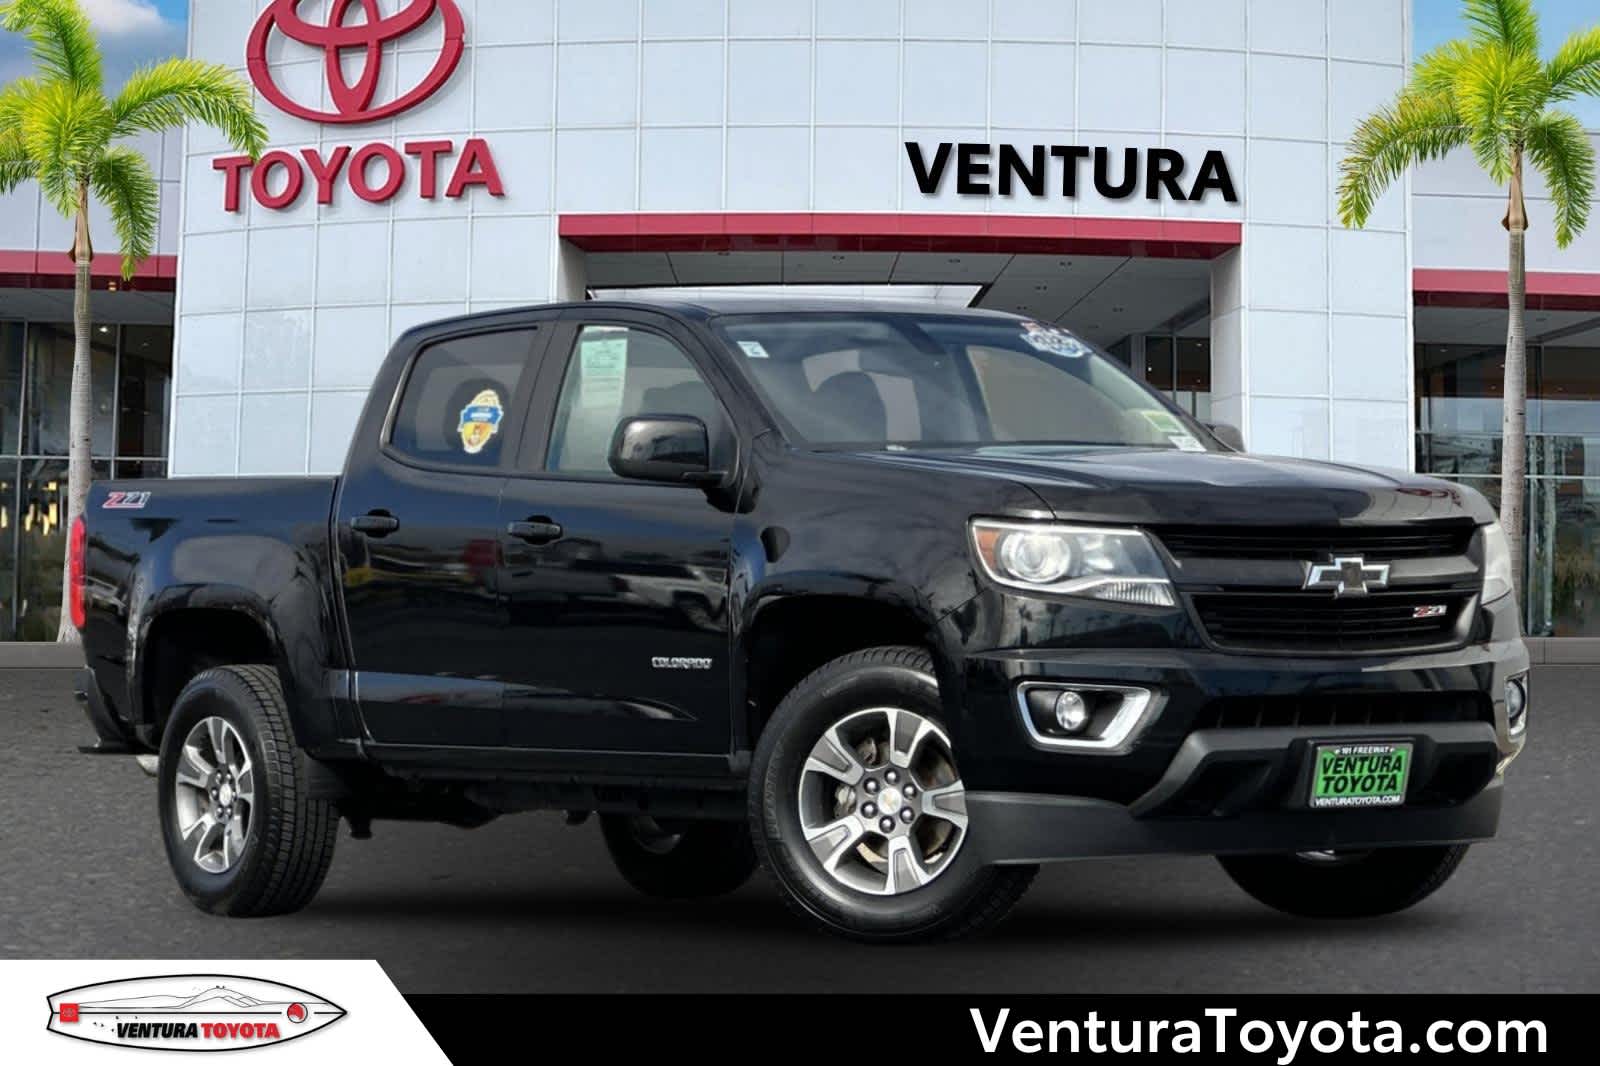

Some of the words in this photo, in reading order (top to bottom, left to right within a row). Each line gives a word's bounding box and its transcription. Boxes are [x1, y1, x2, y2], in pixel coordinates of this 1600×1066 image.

[212, 138, 505, 213] TOYOTA
[904, 141, 1239, 203] VENTURA
[102, 491, 152, 509] Z71
[1413, 604, 1448, 618] Z71
[651, 656, 712, 669] COLORADO
[1353, 745, 1389, 754] FREEWAY
[1322, 755, 1403, 775] VENTURA
[1322, 774, 1398, 794] TOYOTA
